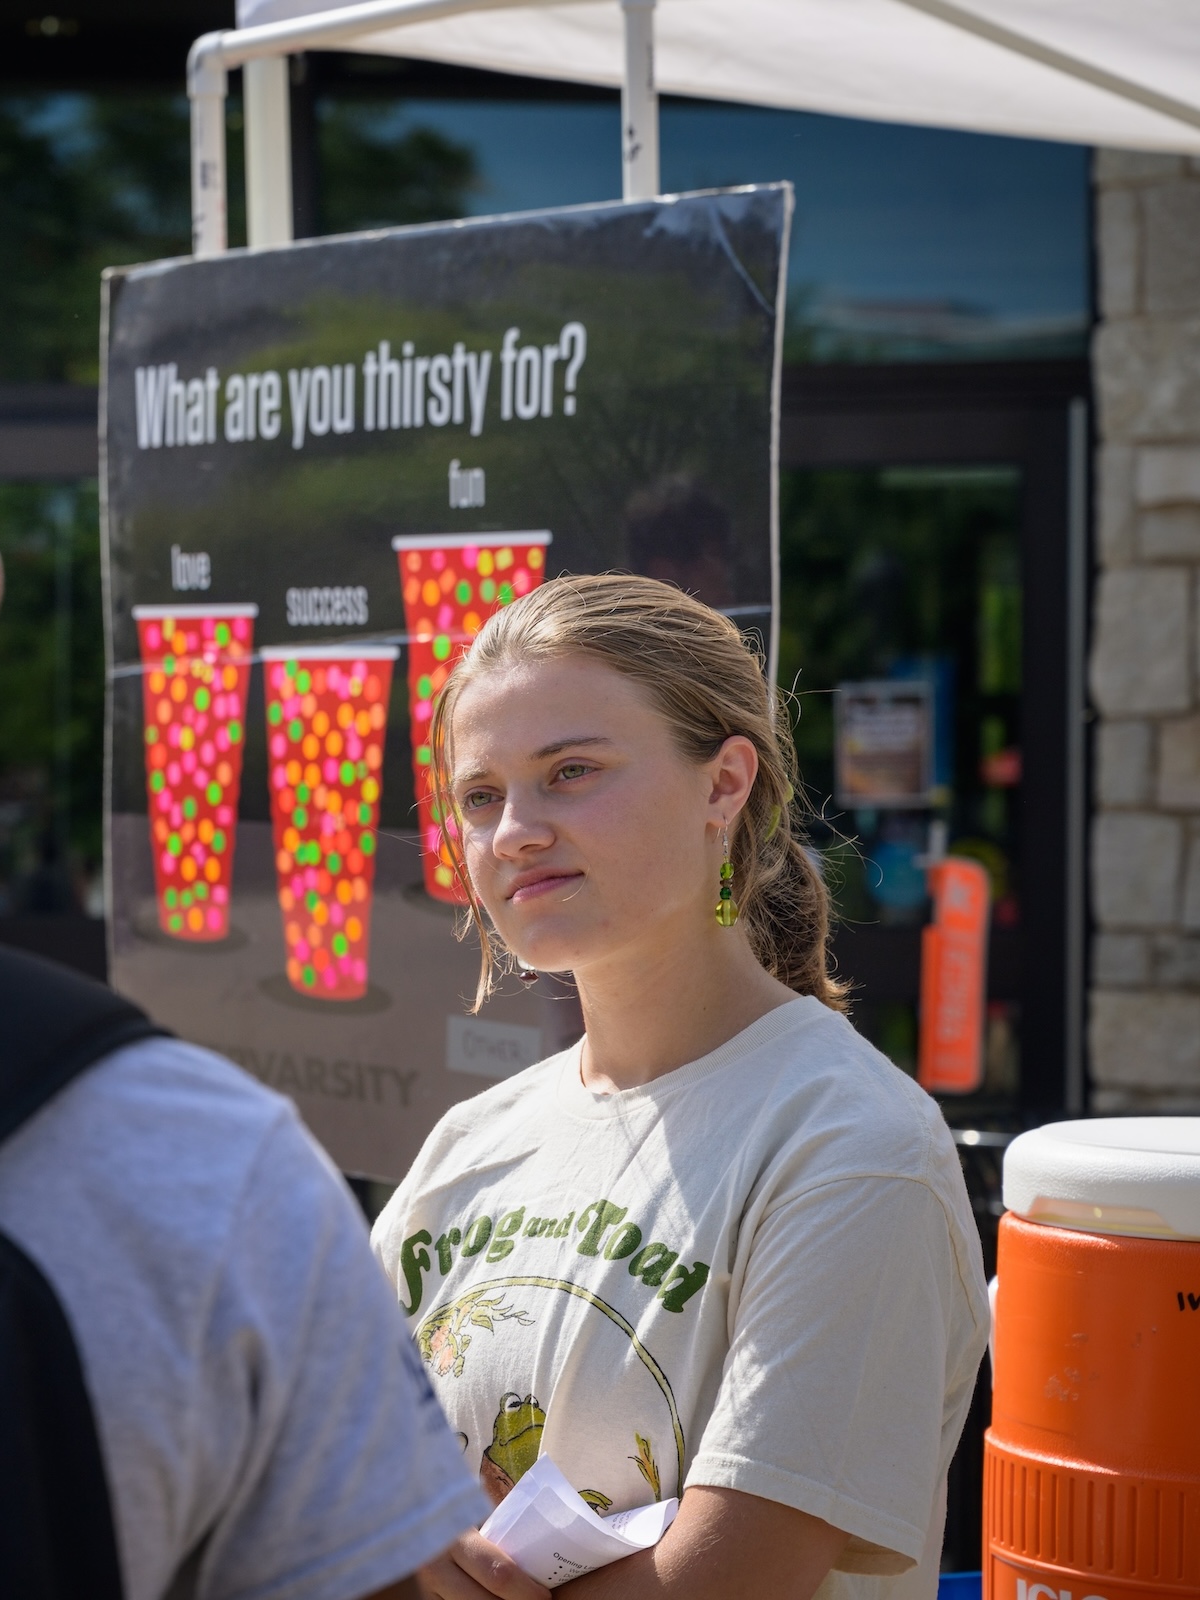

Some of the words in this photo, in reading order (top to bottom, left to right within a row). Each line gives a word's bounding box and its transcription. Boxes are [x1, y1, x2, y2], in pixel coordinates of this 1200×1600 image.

[135, 361, 220, 450] What
[224, 369, 282, 443] are
[287, 362, 356, 450] you
[362, 339, 492, 437] thirsty
[500, 321, 588, 421] for?
[448, 458, 485, 509] fun
[171, 543, 211, 591] love
[286, 585, 369, 626] success
[399, 1206, 527, 1318] Frog
[522, 1211, 576, 1239] and
[577, 1199, 710, 1313] Toad
[553, 1552, 583, 1569] Opening
